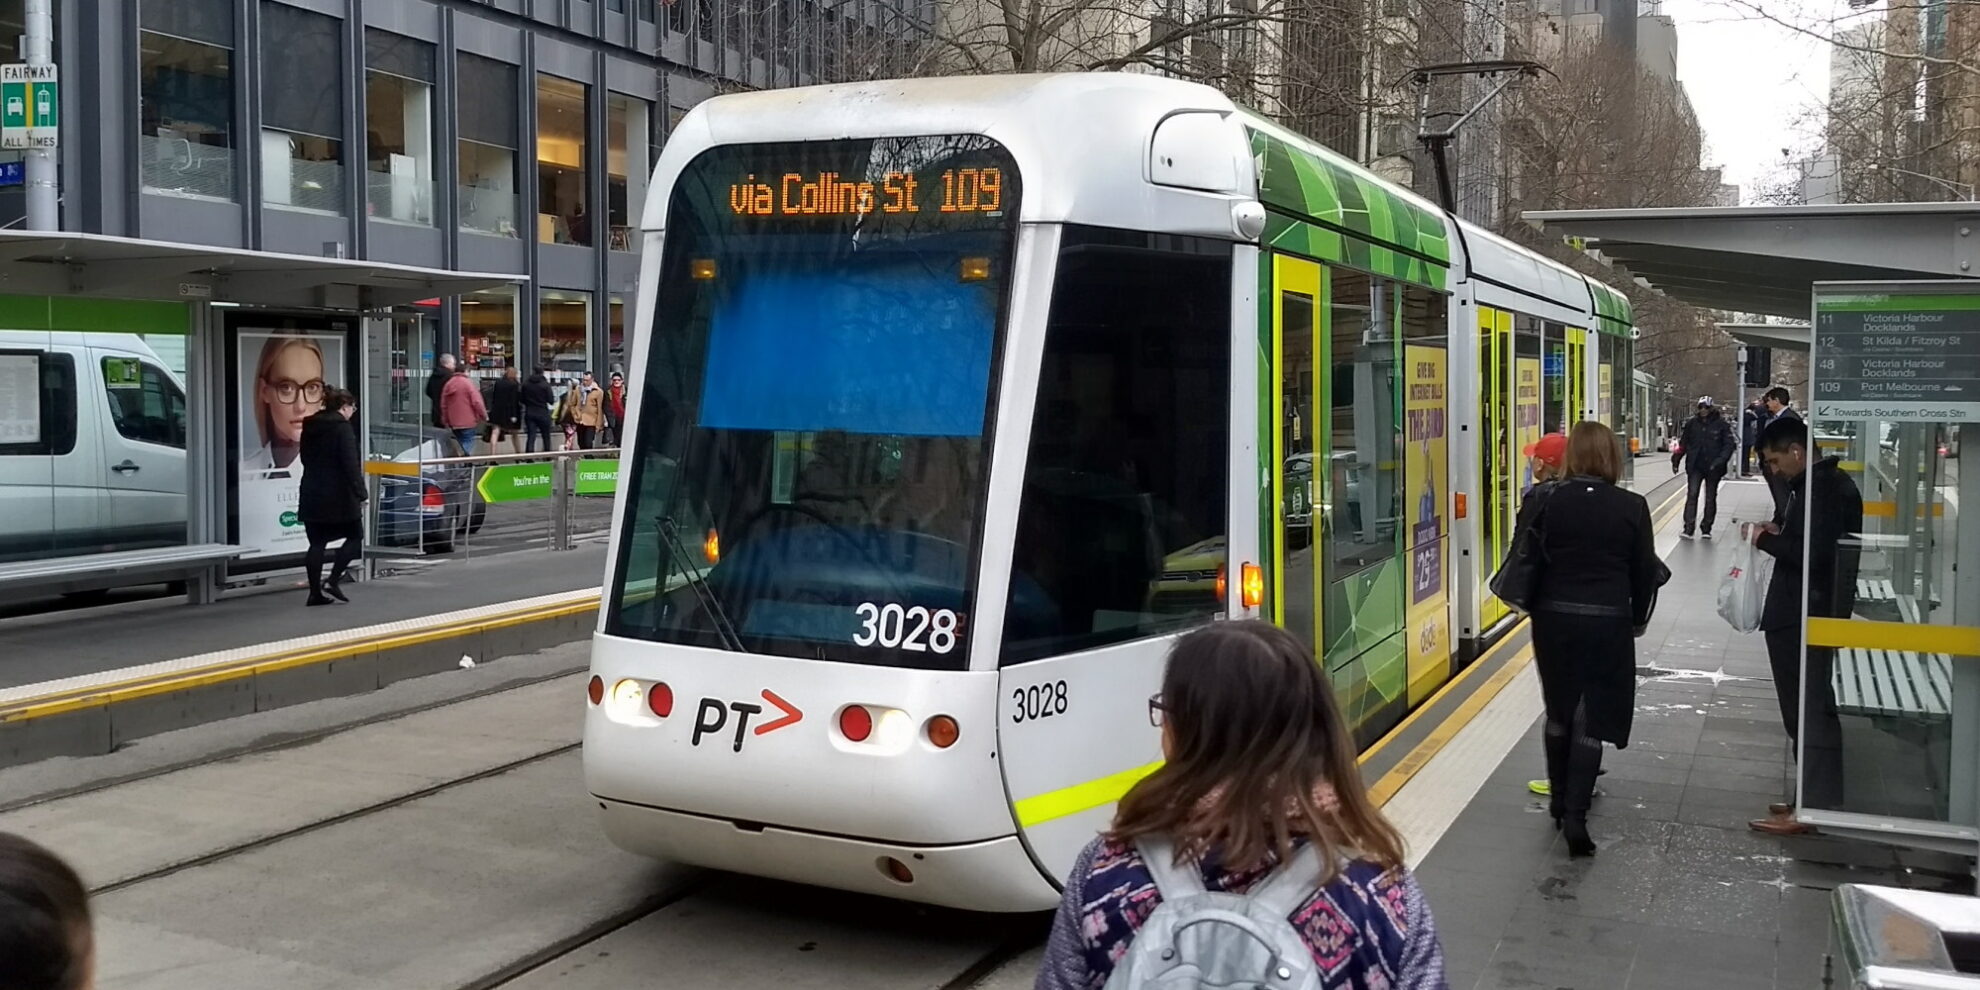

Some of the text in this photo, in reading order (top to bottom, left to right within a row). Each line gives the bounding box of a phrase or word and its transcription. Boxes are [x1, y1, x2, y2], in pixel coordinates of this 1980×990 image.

[4, 66, 53, 79] FAIRWAY
[4, 136, 55, 147] ALL TIMES
[730, 167, 1001, 214] via Collins St 109
[1820, 314, 1944, 324] 11 Victoria Harbour
[1863, 323, 1916, 332] Docklands
[1820, 337, 1835, 347] 12
[1862, 336, 1874, 345] St
[1876, 336, 1902, 345] Kilda
[1911, 336, 1947, 347] Fitzroy
[1949, 336, 1961, 345] St
[1819, 359, 1945, 370] 48 Victoria Harbour
[1862, 368, 1916, 377] Docklands
[1819, 382, 1941, 392] 109 Port Melbourne
[1833, 408, 1967, 418] Towards Southern Cross Stn
[1408, 409, 1424, 442] THE
[513, 475, 532, 487] You're
[583, 471, 597, 480] FREE
[853, 603, 957, 654] 3028
[1012, 679, 1069, 724] 3028
